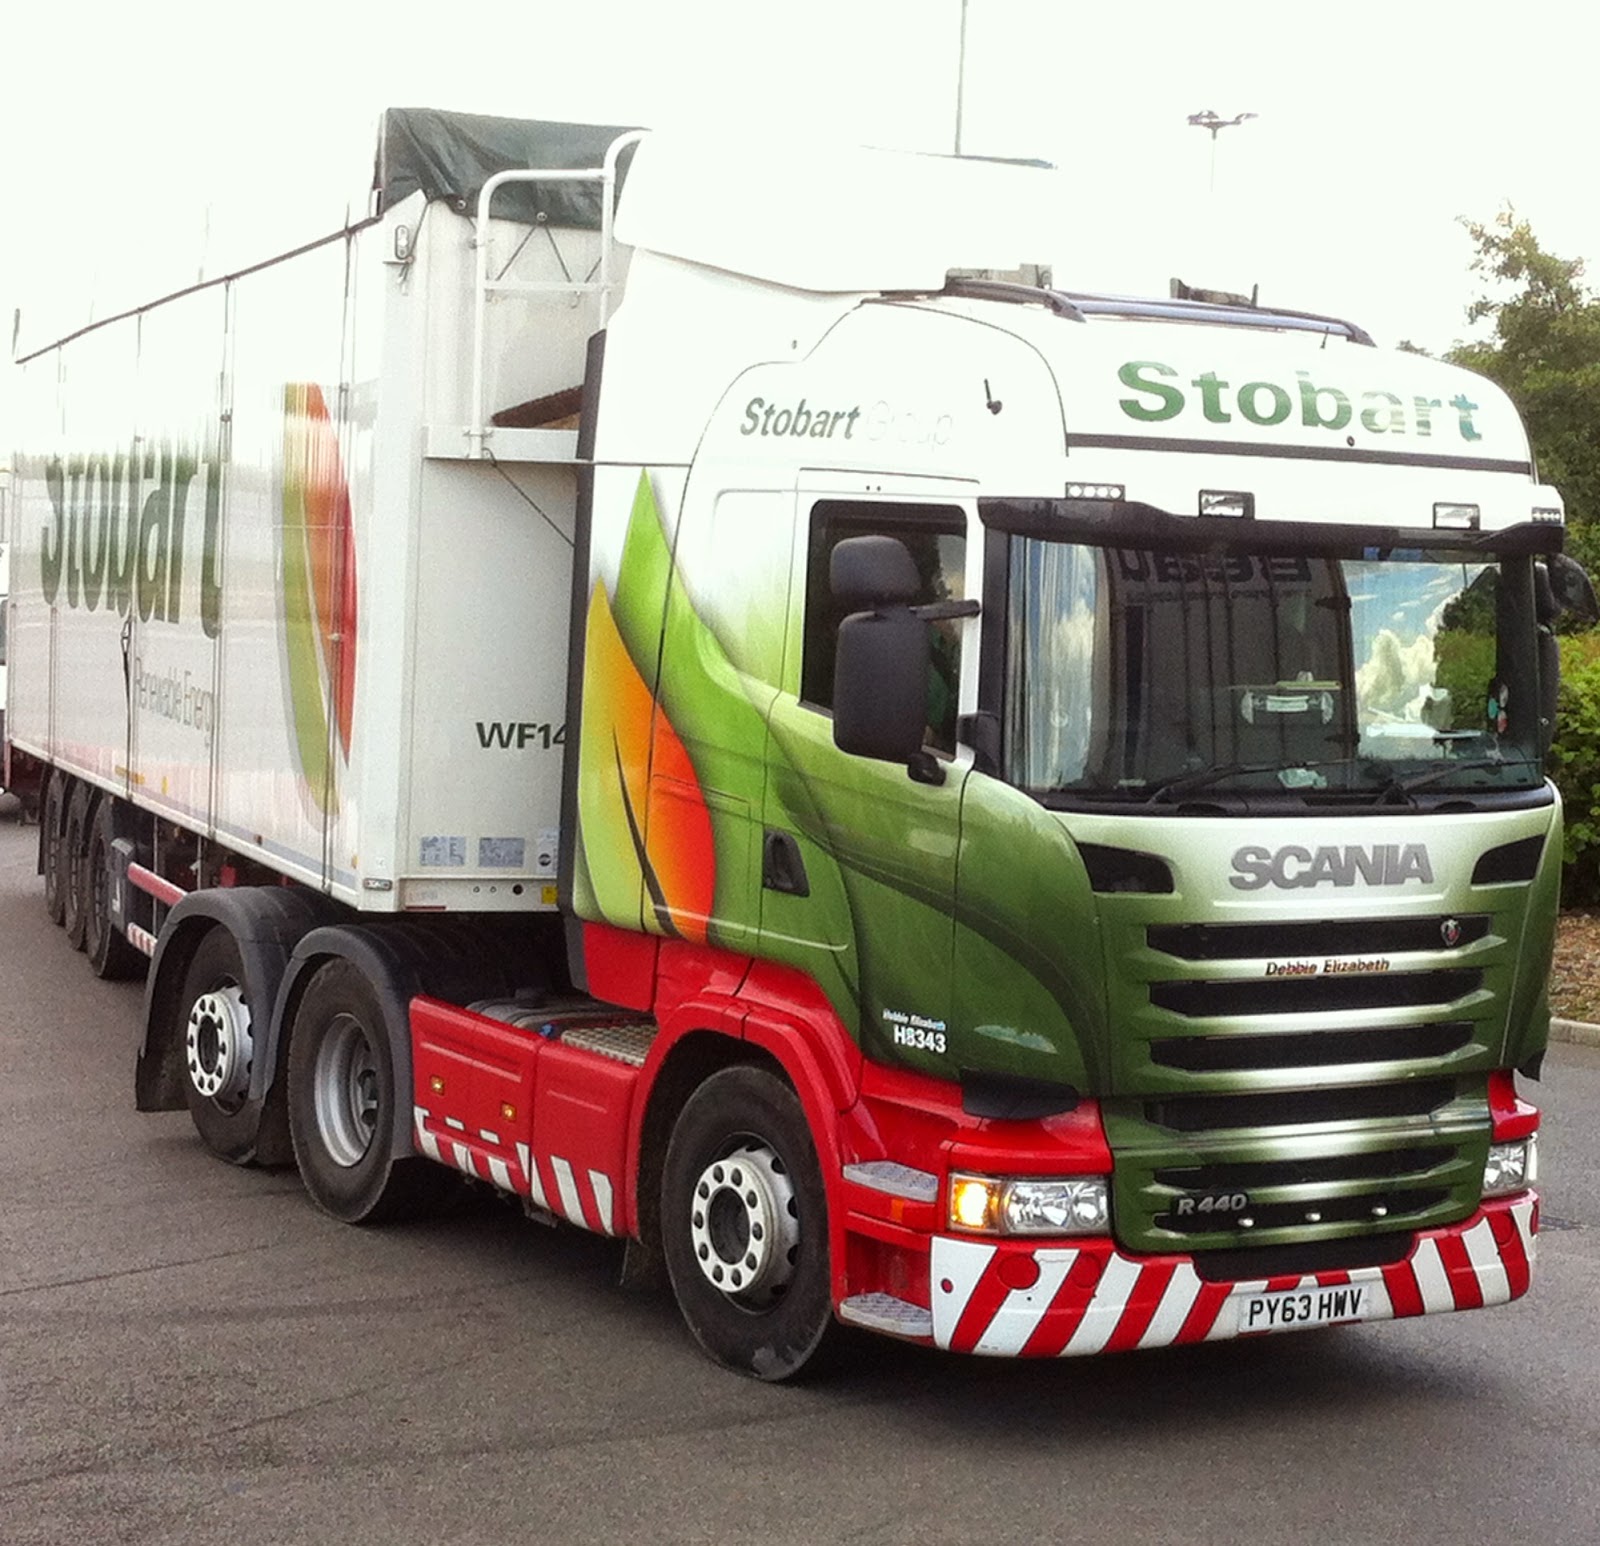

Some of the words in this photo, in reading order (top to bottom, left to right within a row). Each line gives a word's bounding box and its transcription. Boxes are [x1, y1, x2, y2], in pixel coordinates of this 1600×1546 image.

[740, 397, 861, 440] Stobart
[1117, 360, 1483, 442] Stobart
[40, 449, 223, 639] Stobart
[1228, 843, 1435, 891] SCANIA
[1265, 961, 1319, 977] Debbie
[1322, 957, 1391, 974] Elizabeth
[893, 1023, 947, 1054] H8343
[1177, 1197, 1194, 1216] R
[1197, 1193, 1248, 1214] 440
[1248, 1295, 1313, 1327] PY63
[1317, 1287, 1362, 1321] HWV
